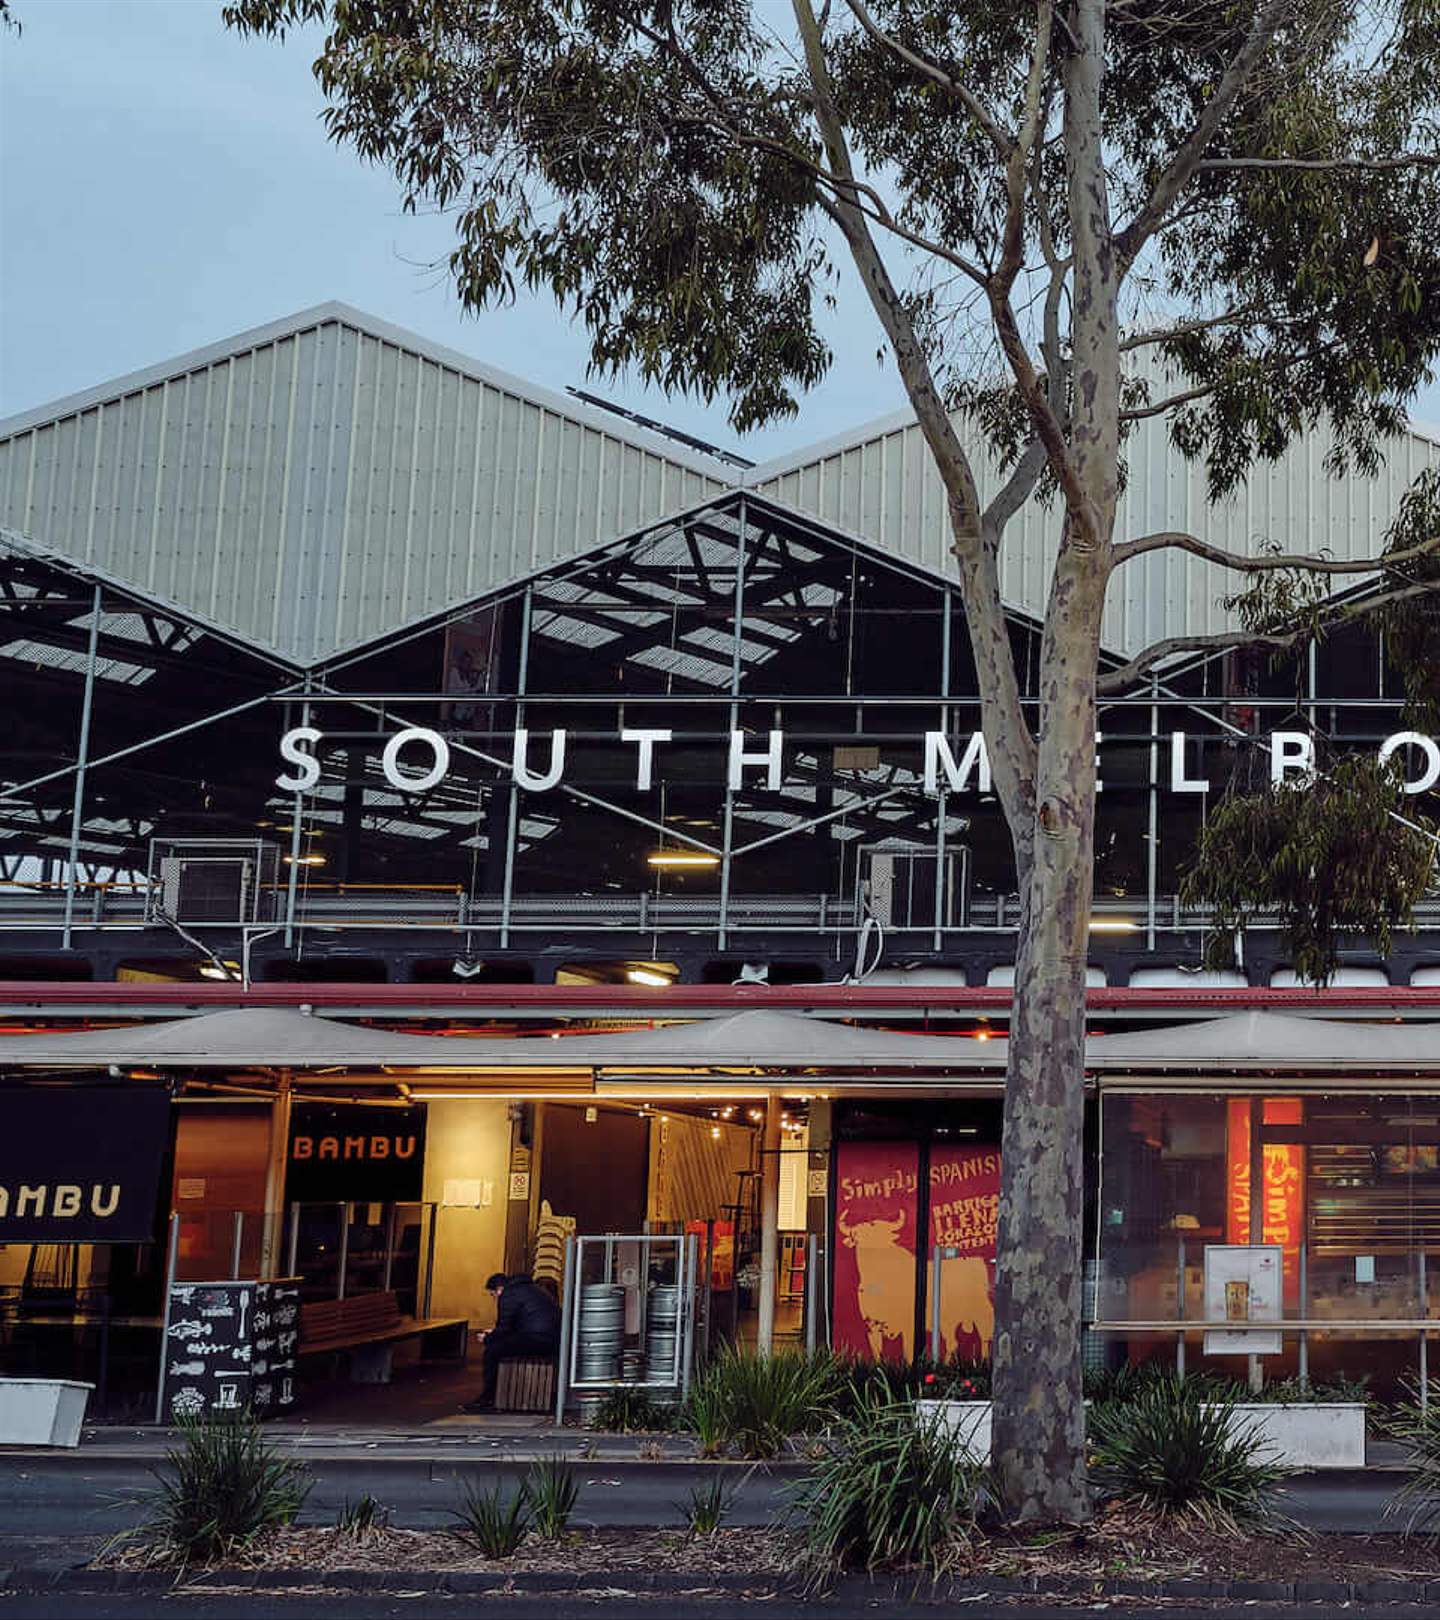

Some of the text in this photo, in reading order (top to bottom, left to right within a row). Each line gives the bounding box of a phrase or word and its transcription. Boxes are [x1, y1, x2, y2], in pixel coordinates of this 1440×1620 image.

[275, 727, 783, 792] SOUTH
[293, 1136, 417, 1160] BAMBU
[840, 1169, 918, 1201] Simply
[1262, 1152, 1299, 1276] Simp
[938, 1222, 998, 1244] CORAZO
